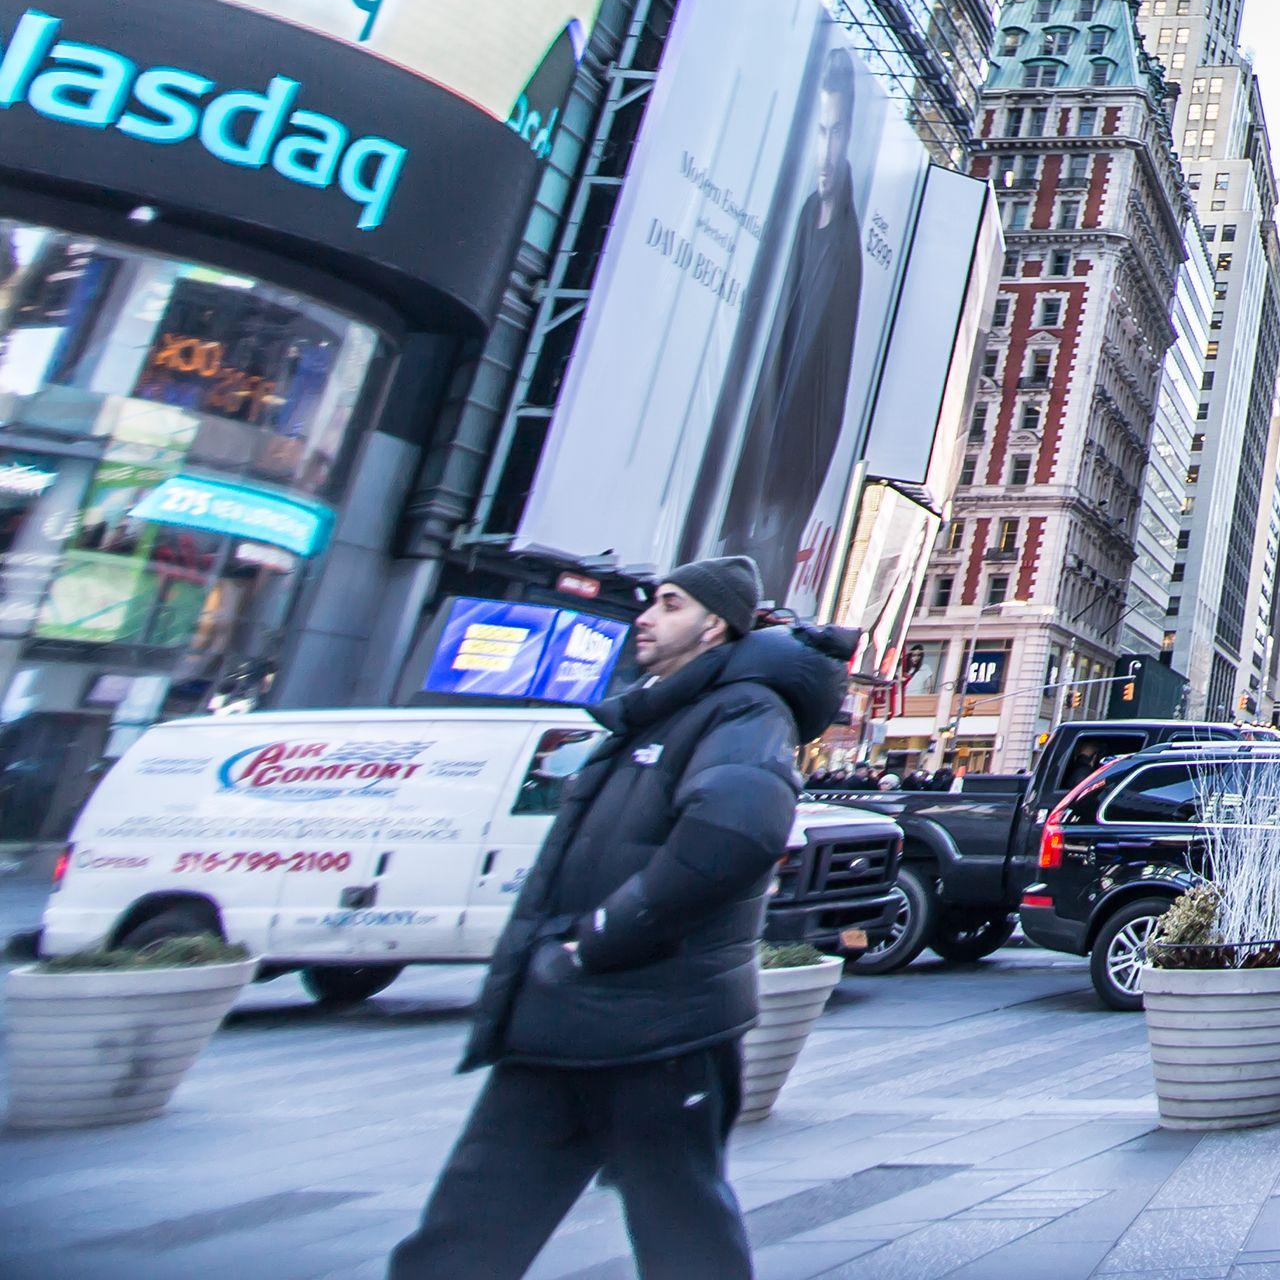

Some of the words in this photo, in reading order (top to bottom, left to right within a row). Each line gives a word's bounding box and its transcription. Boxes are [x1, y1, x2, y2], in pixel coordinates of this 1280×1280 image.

[645, 217, 694, 271] DAVID
[970, 662, 996, 683] GAP
[239, 742, 330, 783] AIR
[250, 762, 423, 788] COMFORT
